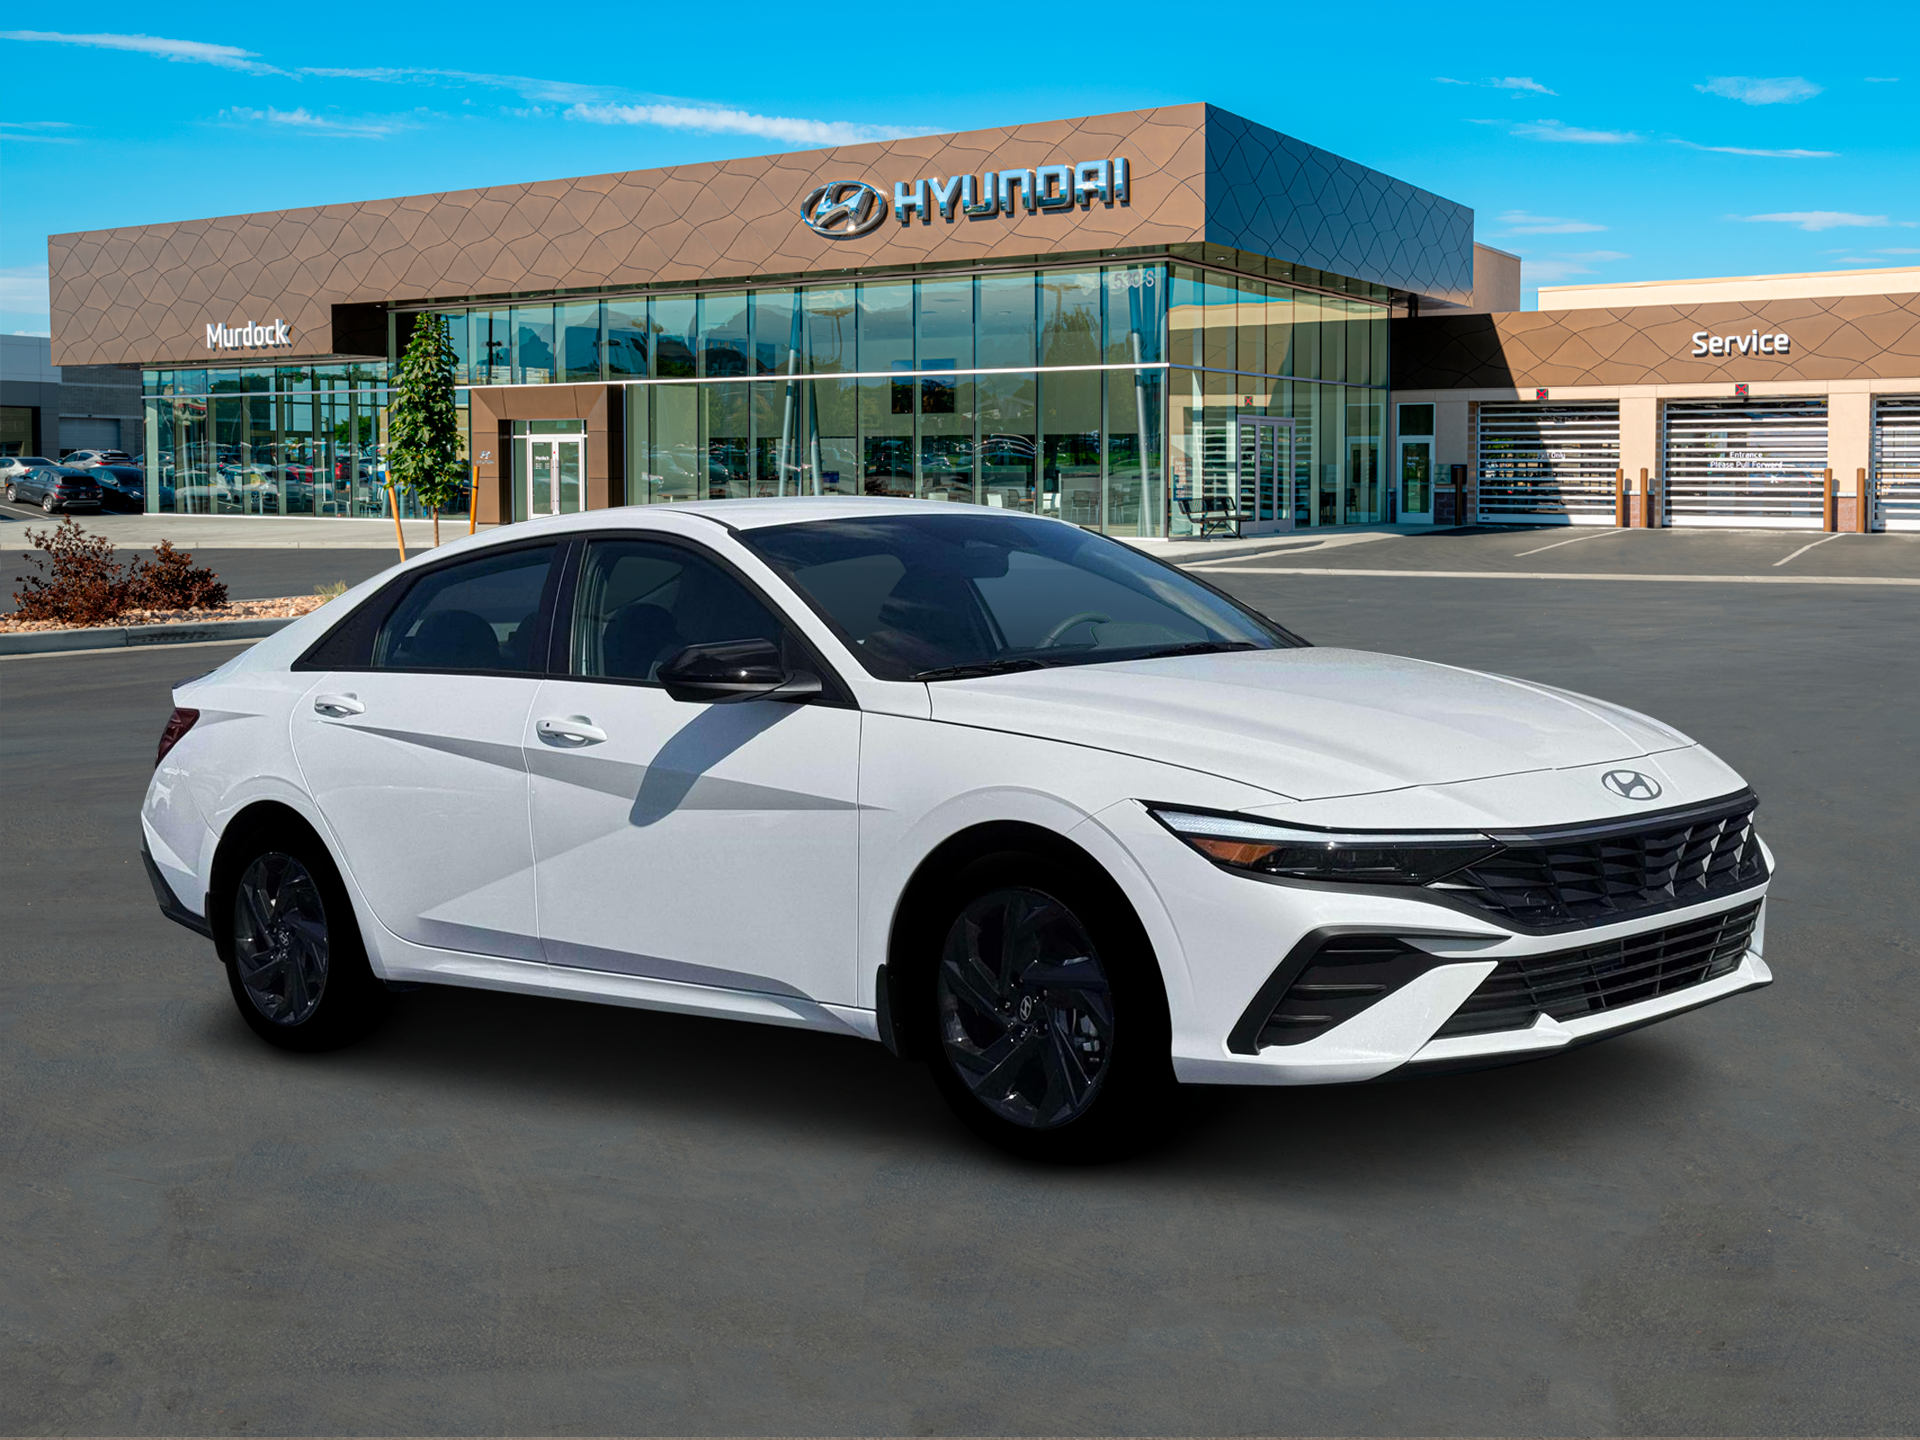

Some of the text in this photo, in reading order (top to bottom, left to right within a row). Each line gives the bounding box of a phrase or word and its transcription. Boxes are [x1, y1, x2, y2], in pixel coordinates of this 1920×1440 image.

[895, 158, 1129, 223] HYUNDAI
[1113, 270, 1155, 289] 530 S
[206, 319, 291, 348] Murdock
[1691, 329, 1789, 354] Service
[1551, 451, 1566, 460] Only
